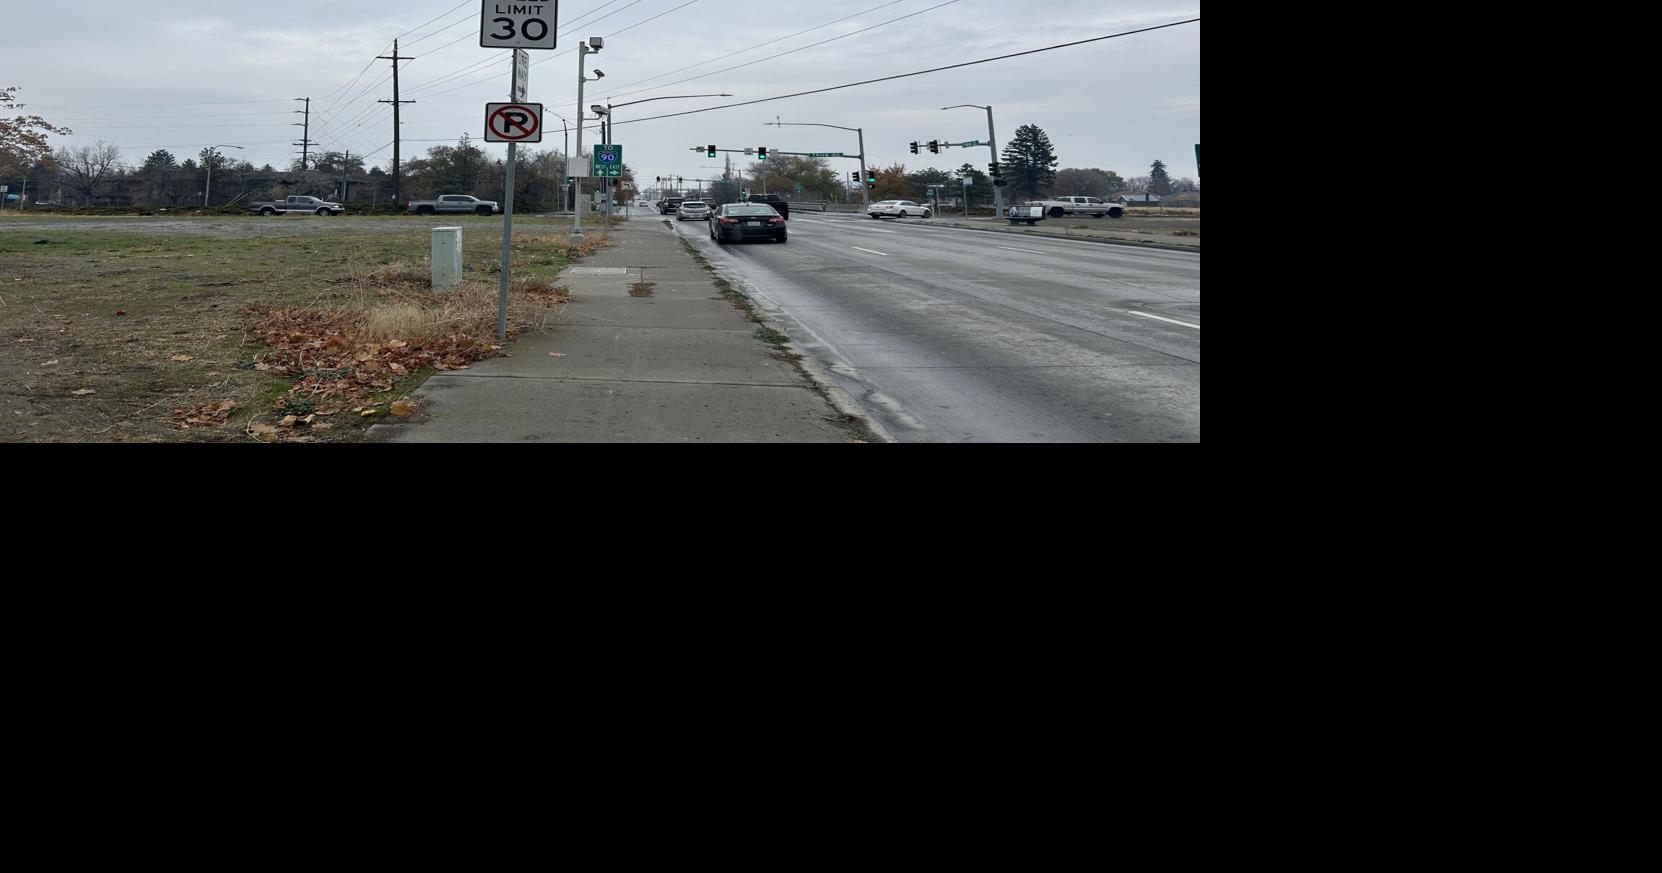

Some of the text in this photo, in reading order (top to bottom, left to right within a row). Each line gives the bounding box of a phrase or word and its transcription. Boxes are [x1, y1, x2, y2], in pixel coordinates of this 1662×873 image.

[496, 4, 544, 15] LIMIT
[490, 17, 548, 41] 30
[504, 112, 528, 133] P
